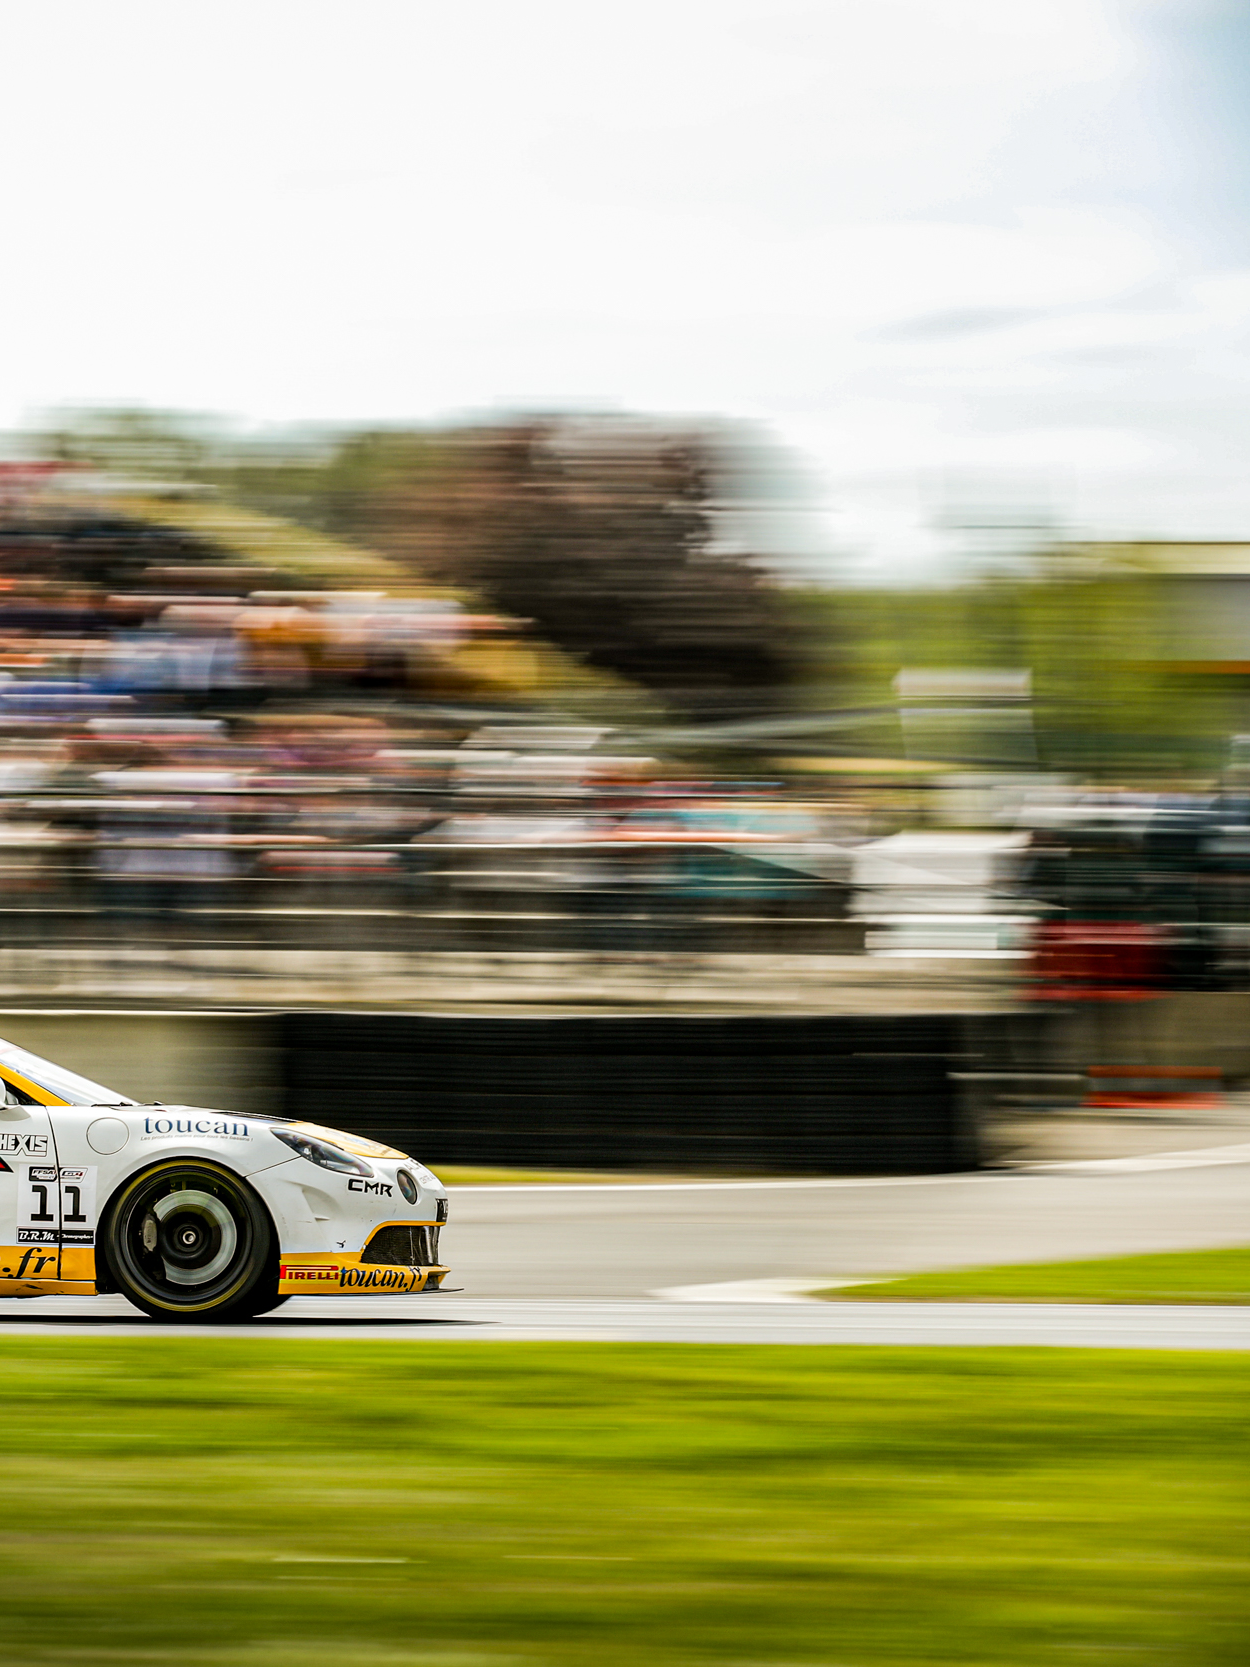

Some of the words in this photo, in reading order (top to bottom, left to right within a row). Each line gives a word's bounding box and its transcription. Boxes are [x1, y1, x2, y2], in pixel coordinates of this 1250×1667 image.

[144, 1116, 250, 1137] toucan
[347, 1178, 393, 1198] CMR
[30, 1184, 87, 1222] 11
[279, 1265, 339, 1280] PIRELLI
[338, 1265, 424, 1293] toucan.fr
